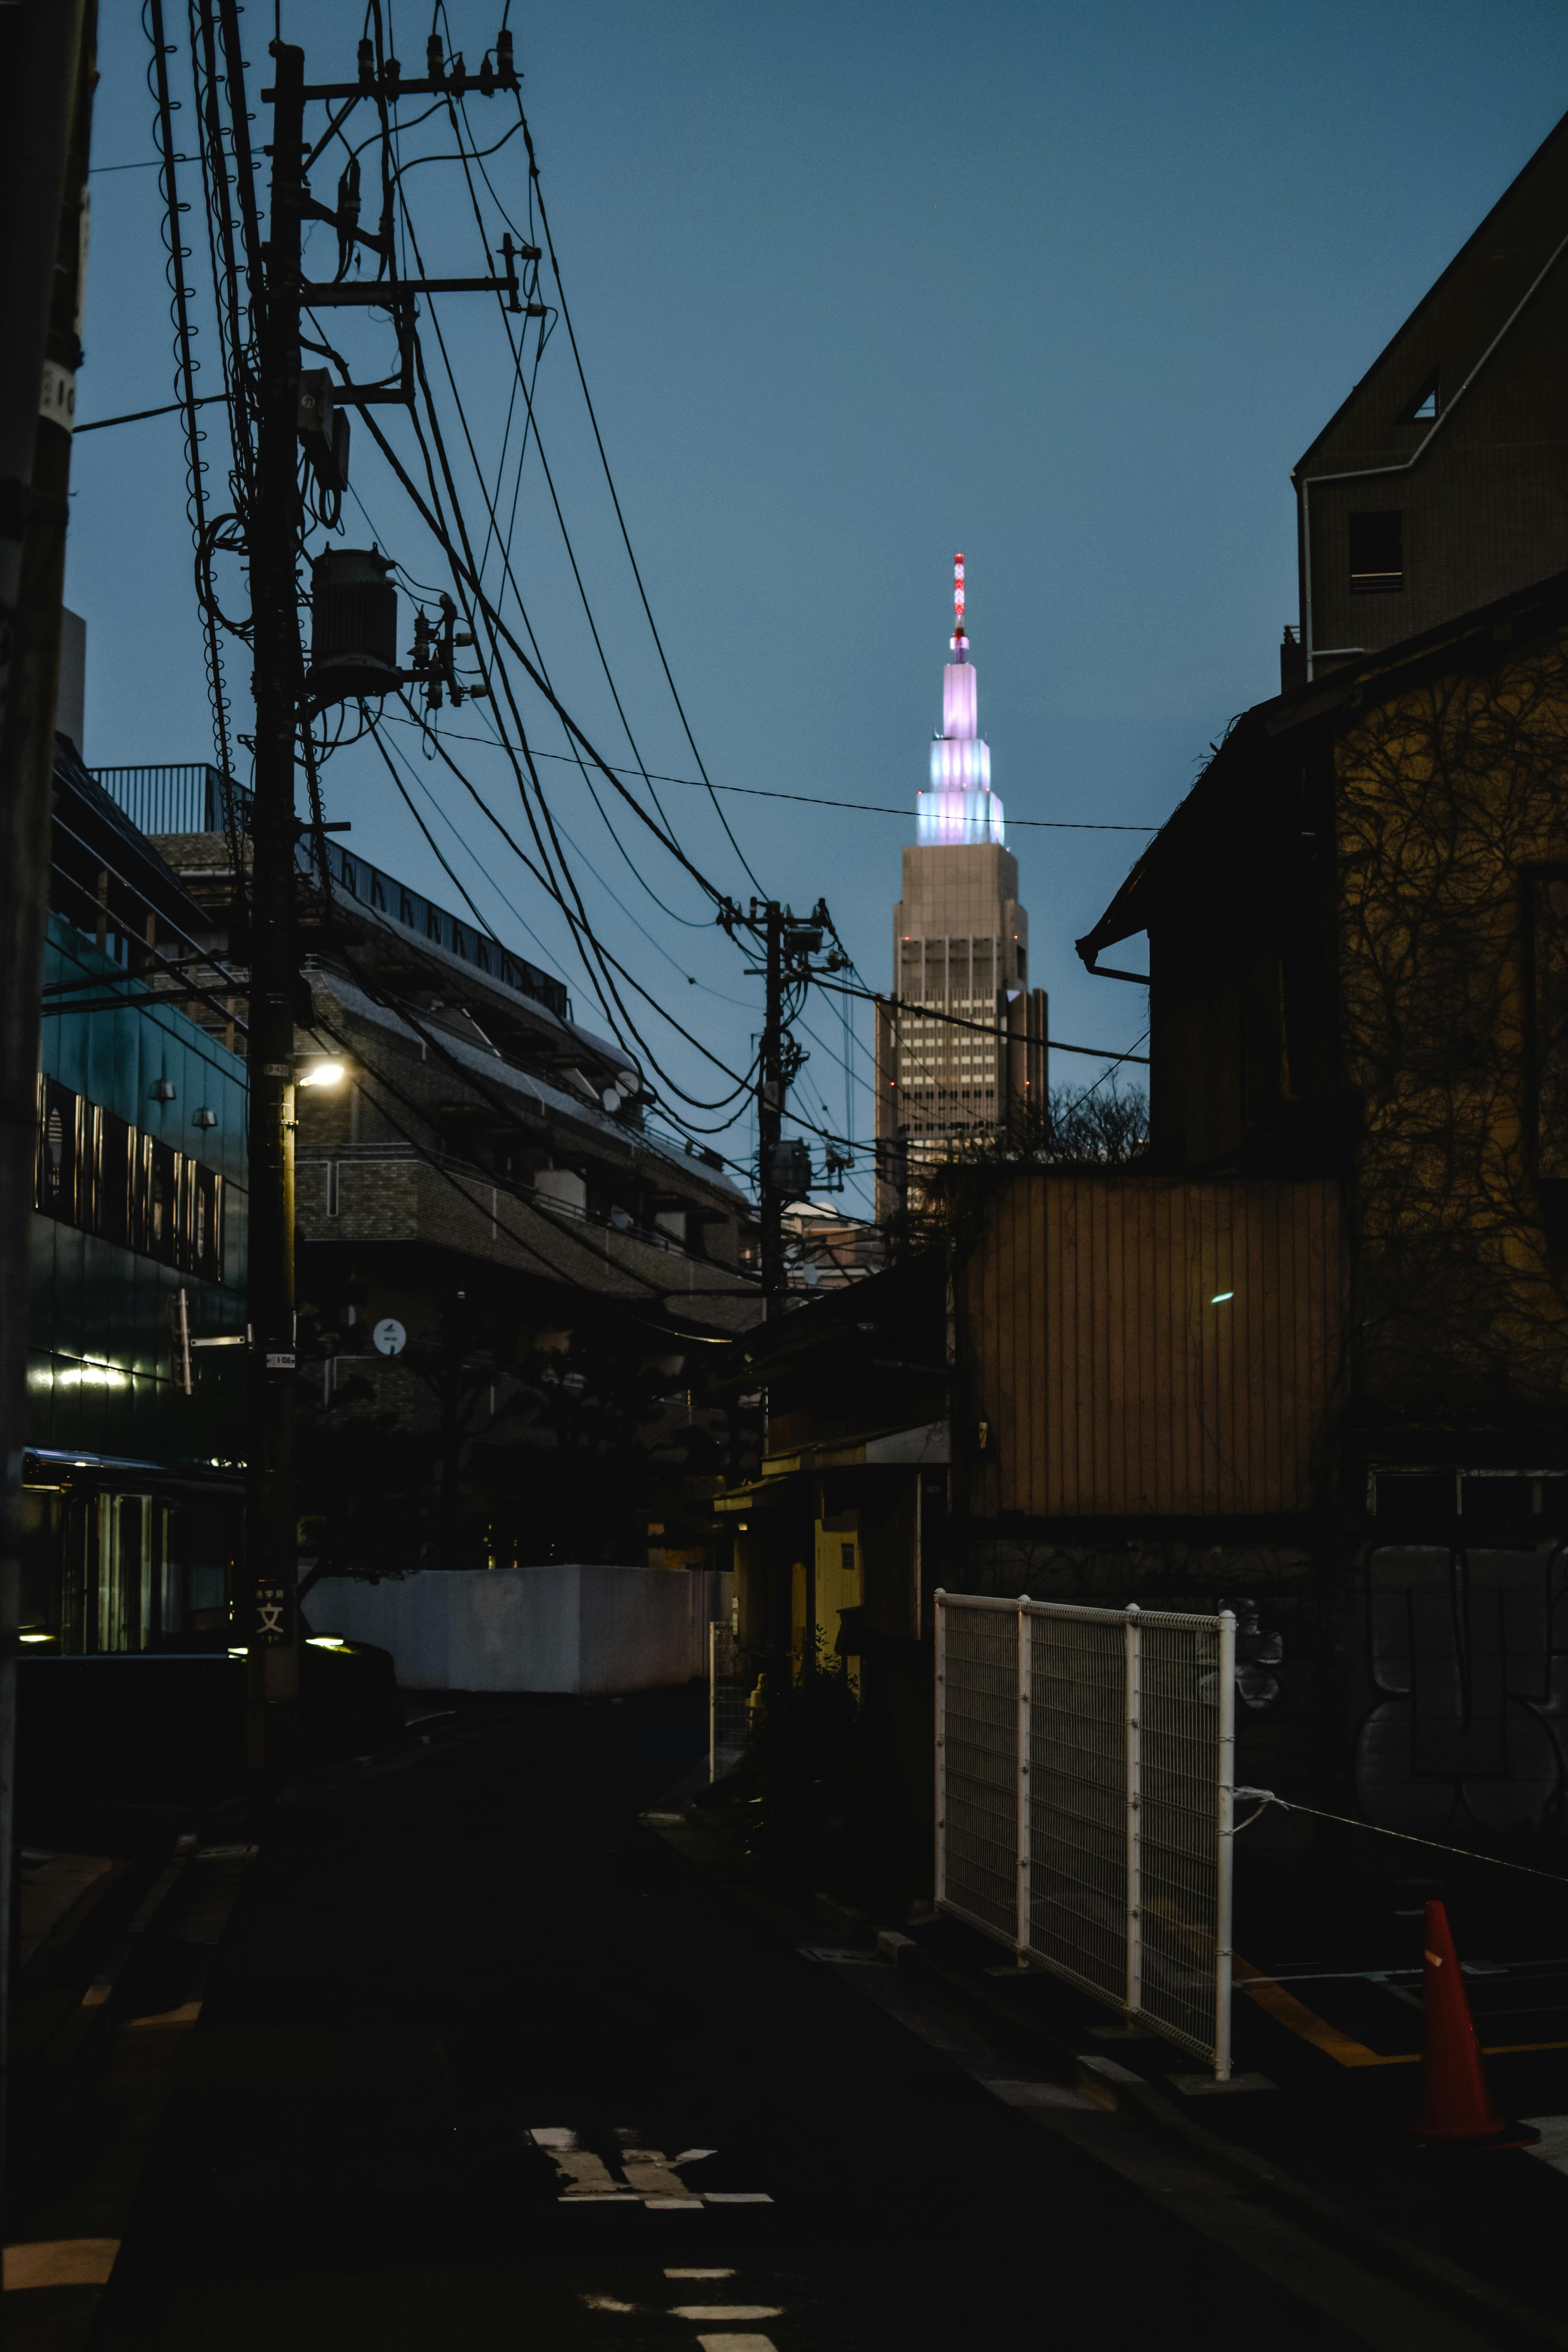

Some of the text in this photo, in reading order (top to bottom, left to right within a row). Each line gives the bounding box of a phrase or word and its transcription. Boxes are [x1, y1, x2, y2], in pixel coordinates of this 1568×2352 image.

[255, 1589, 284, 1598] 通学路
[256, 1602, 284, 1633] 文
